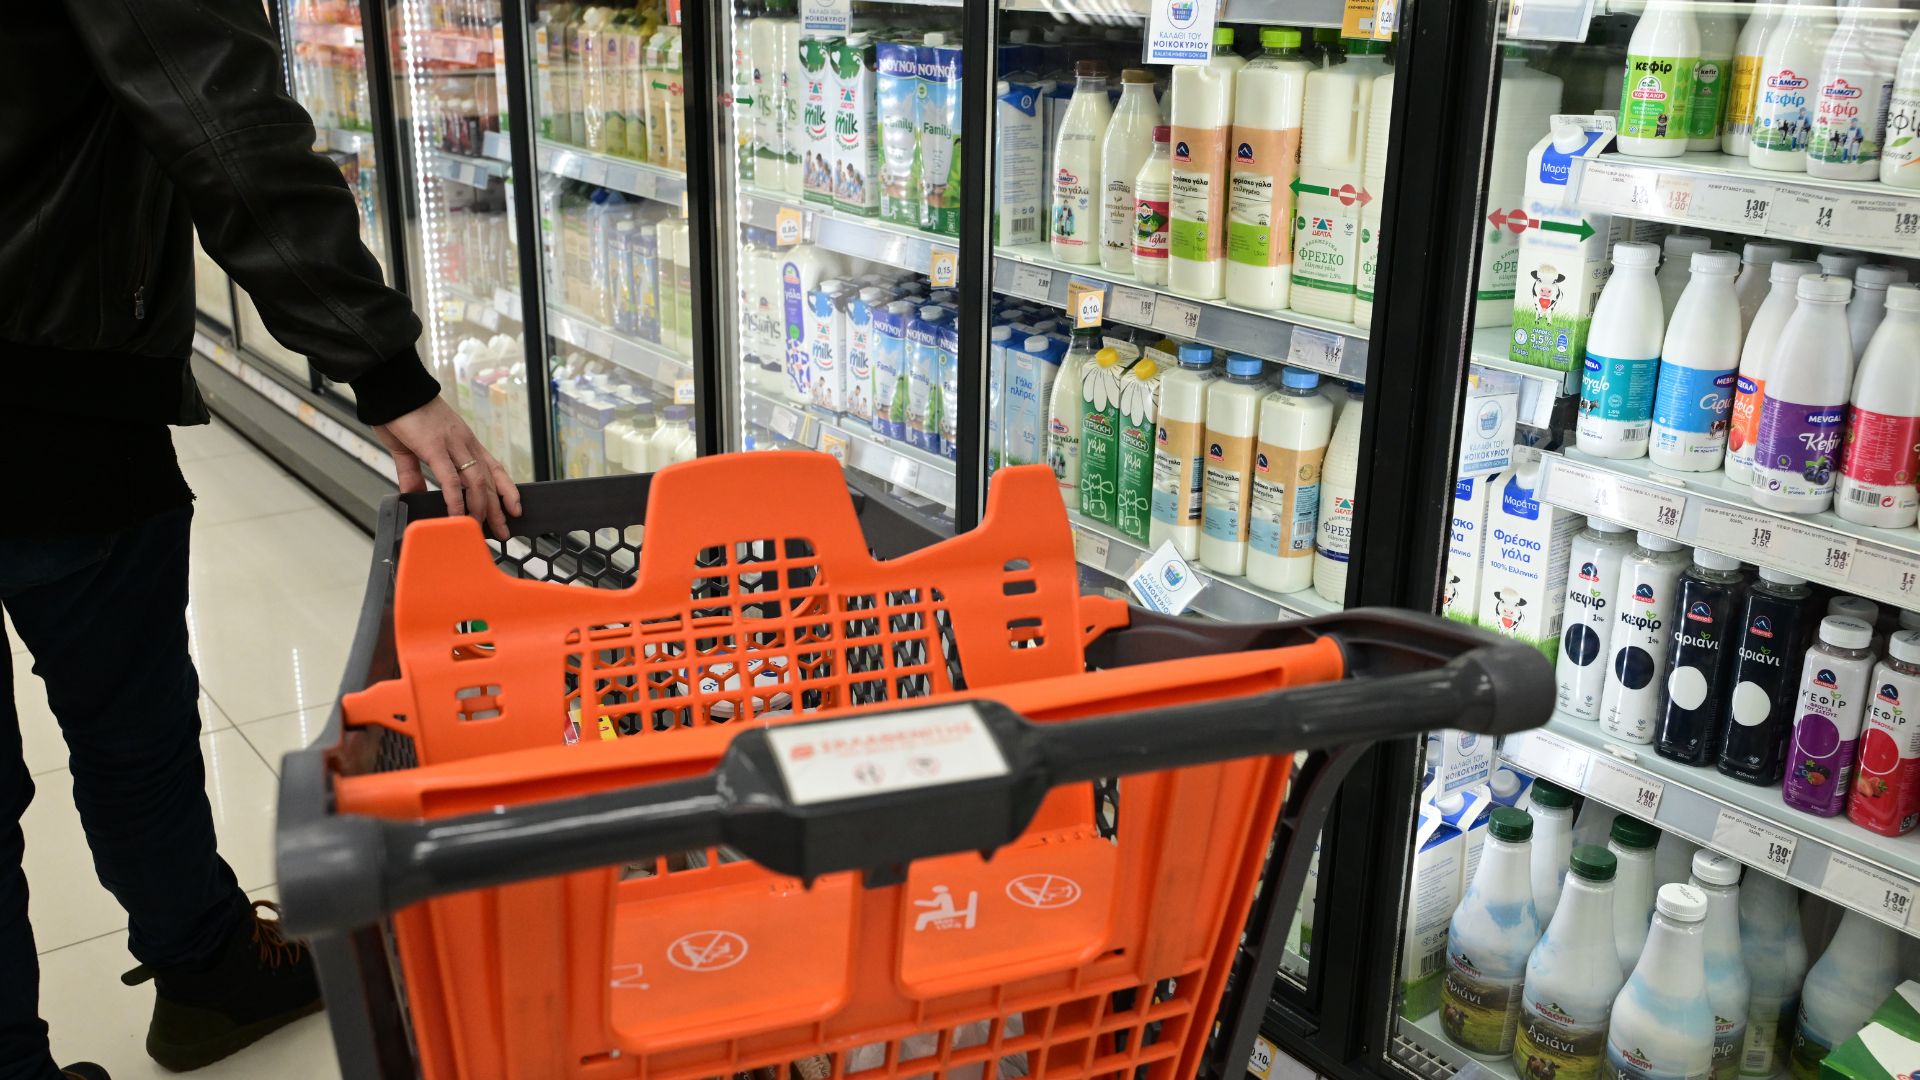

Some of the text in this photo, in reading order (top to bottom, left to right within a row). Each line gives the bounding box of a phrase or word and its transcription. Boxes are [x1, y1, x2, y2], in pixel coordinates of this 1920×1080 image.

[1159, 31, 1202, 40] ΚΑΛΑΘΙ ΤΟΥ
[1153, 40, 1209, 49] ΝΟΙΚΟΚΥΡΙΟΥ
[1635, 60, 1673, 75] κεφίρ
[804, 103, 826, 127] milk
[834, 112, 859, 136] milk
[923, 122, 952, 139] Family
[1542, 160, 1571, 176] Μαράτ
[1255, 180, 1272, 188] γάλα
[1298, 247, 1344, 266] ΦΡΕΣΚΟ
[1492, 260, 1518, 274] ΦΡΕ
[1530, 333, 1554, 346] 3,5%
[1084, 419, 1111, 436] ΤΡΙΚΚΗ
[1808, 415, 1842, 423] MEVGAL
[1087, 437, 1106, 454] γάλα
[1122, 434, 1148, 451] ΤΡΙΚΚΗ
[1798, 432, 1842, 454] Kefir
[1123, 451, 1142, 469] γάλα
[1455, 480, 1471, 492] άτα
[1504, 494, 1538, 512] Μαράτα
[1323, 521, 1352, 538] ΦΡΕΣ
[1451, 516, 1474, 531] σκο
[1450, 527, 1465, 543] λα
[1493, 528, 1541, 552] Φρέσκο
[1449, 546, 1472, 558] λληνικό
[1501, 546, 1531, 564] γάλα
[1490, 560, 1539, 581] 100% Ελληνικό
[1138, 574, 1169, 614] ΝΟΙΚΟΚΥΡΙΟ
[1802, 689, 1847, 710] ΚΕΦΙΡ
[1866, 704, 1906, 726] ΚΕΦΙΡ
[1445, 760, 1489, 781] ΝΟΙΚΟΚΥΡΙΟΥ
[1446, 974, 1481, 1005] Αριάνι
[1528, 1024, 1575, 1053] Αριάνι
